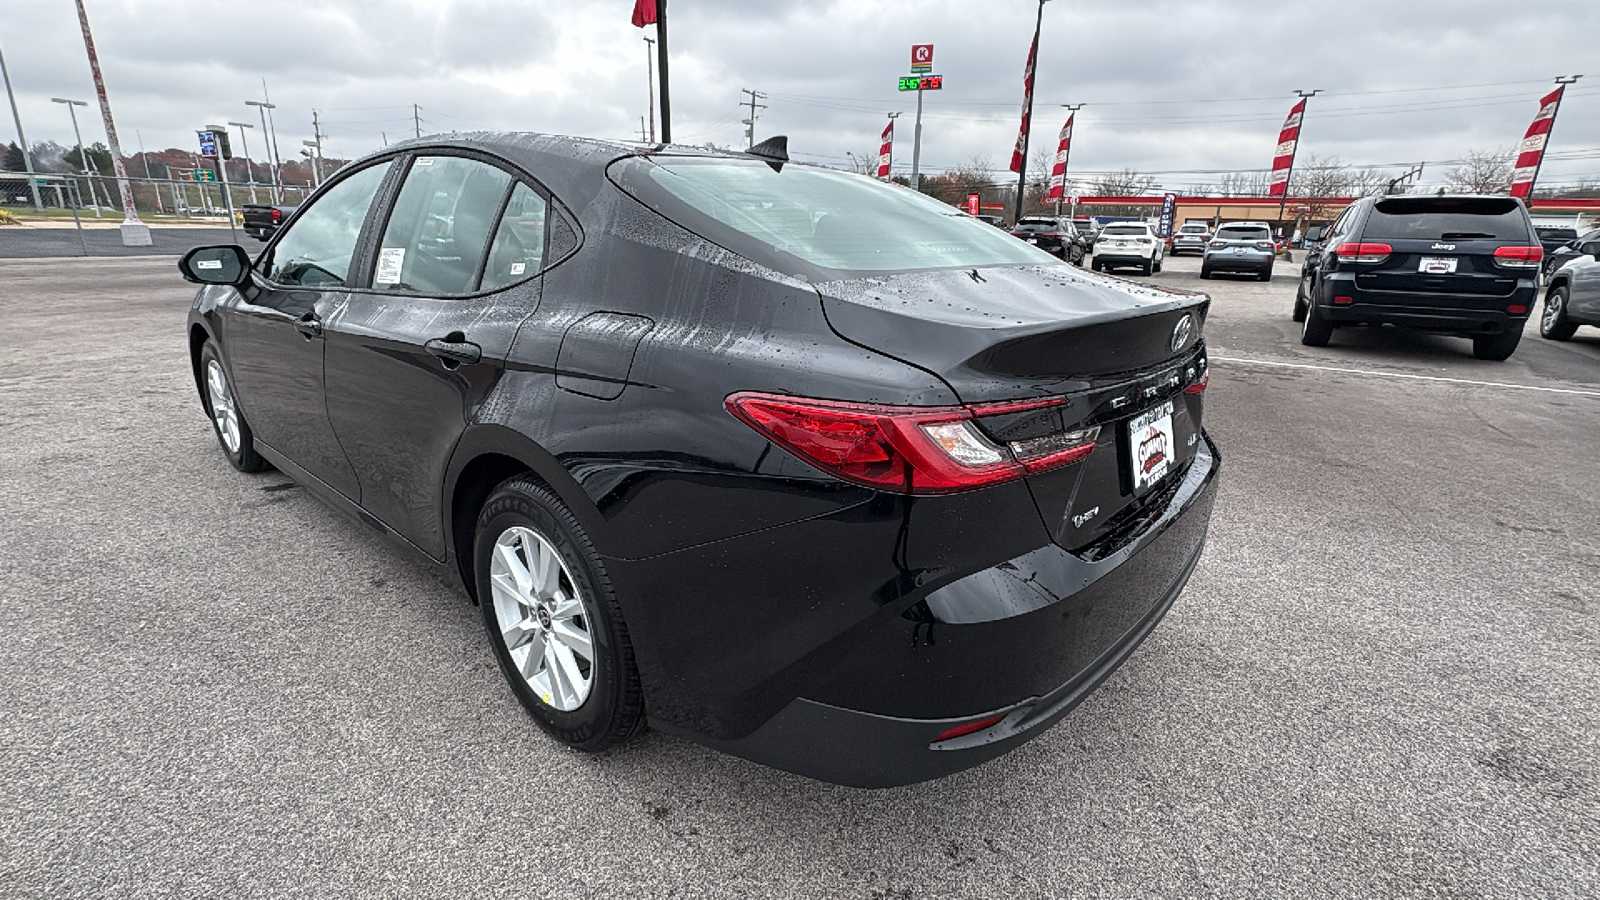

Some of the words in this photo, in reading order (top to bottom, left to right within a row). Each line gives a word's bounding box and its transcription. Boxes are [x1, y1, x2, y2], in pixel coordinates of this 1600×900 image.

[1431, 243, 1456, 251] Jeep
[1139, 436, 1167, 470] SUMMIT
[1147, 467, 1168, 488] AKRON
